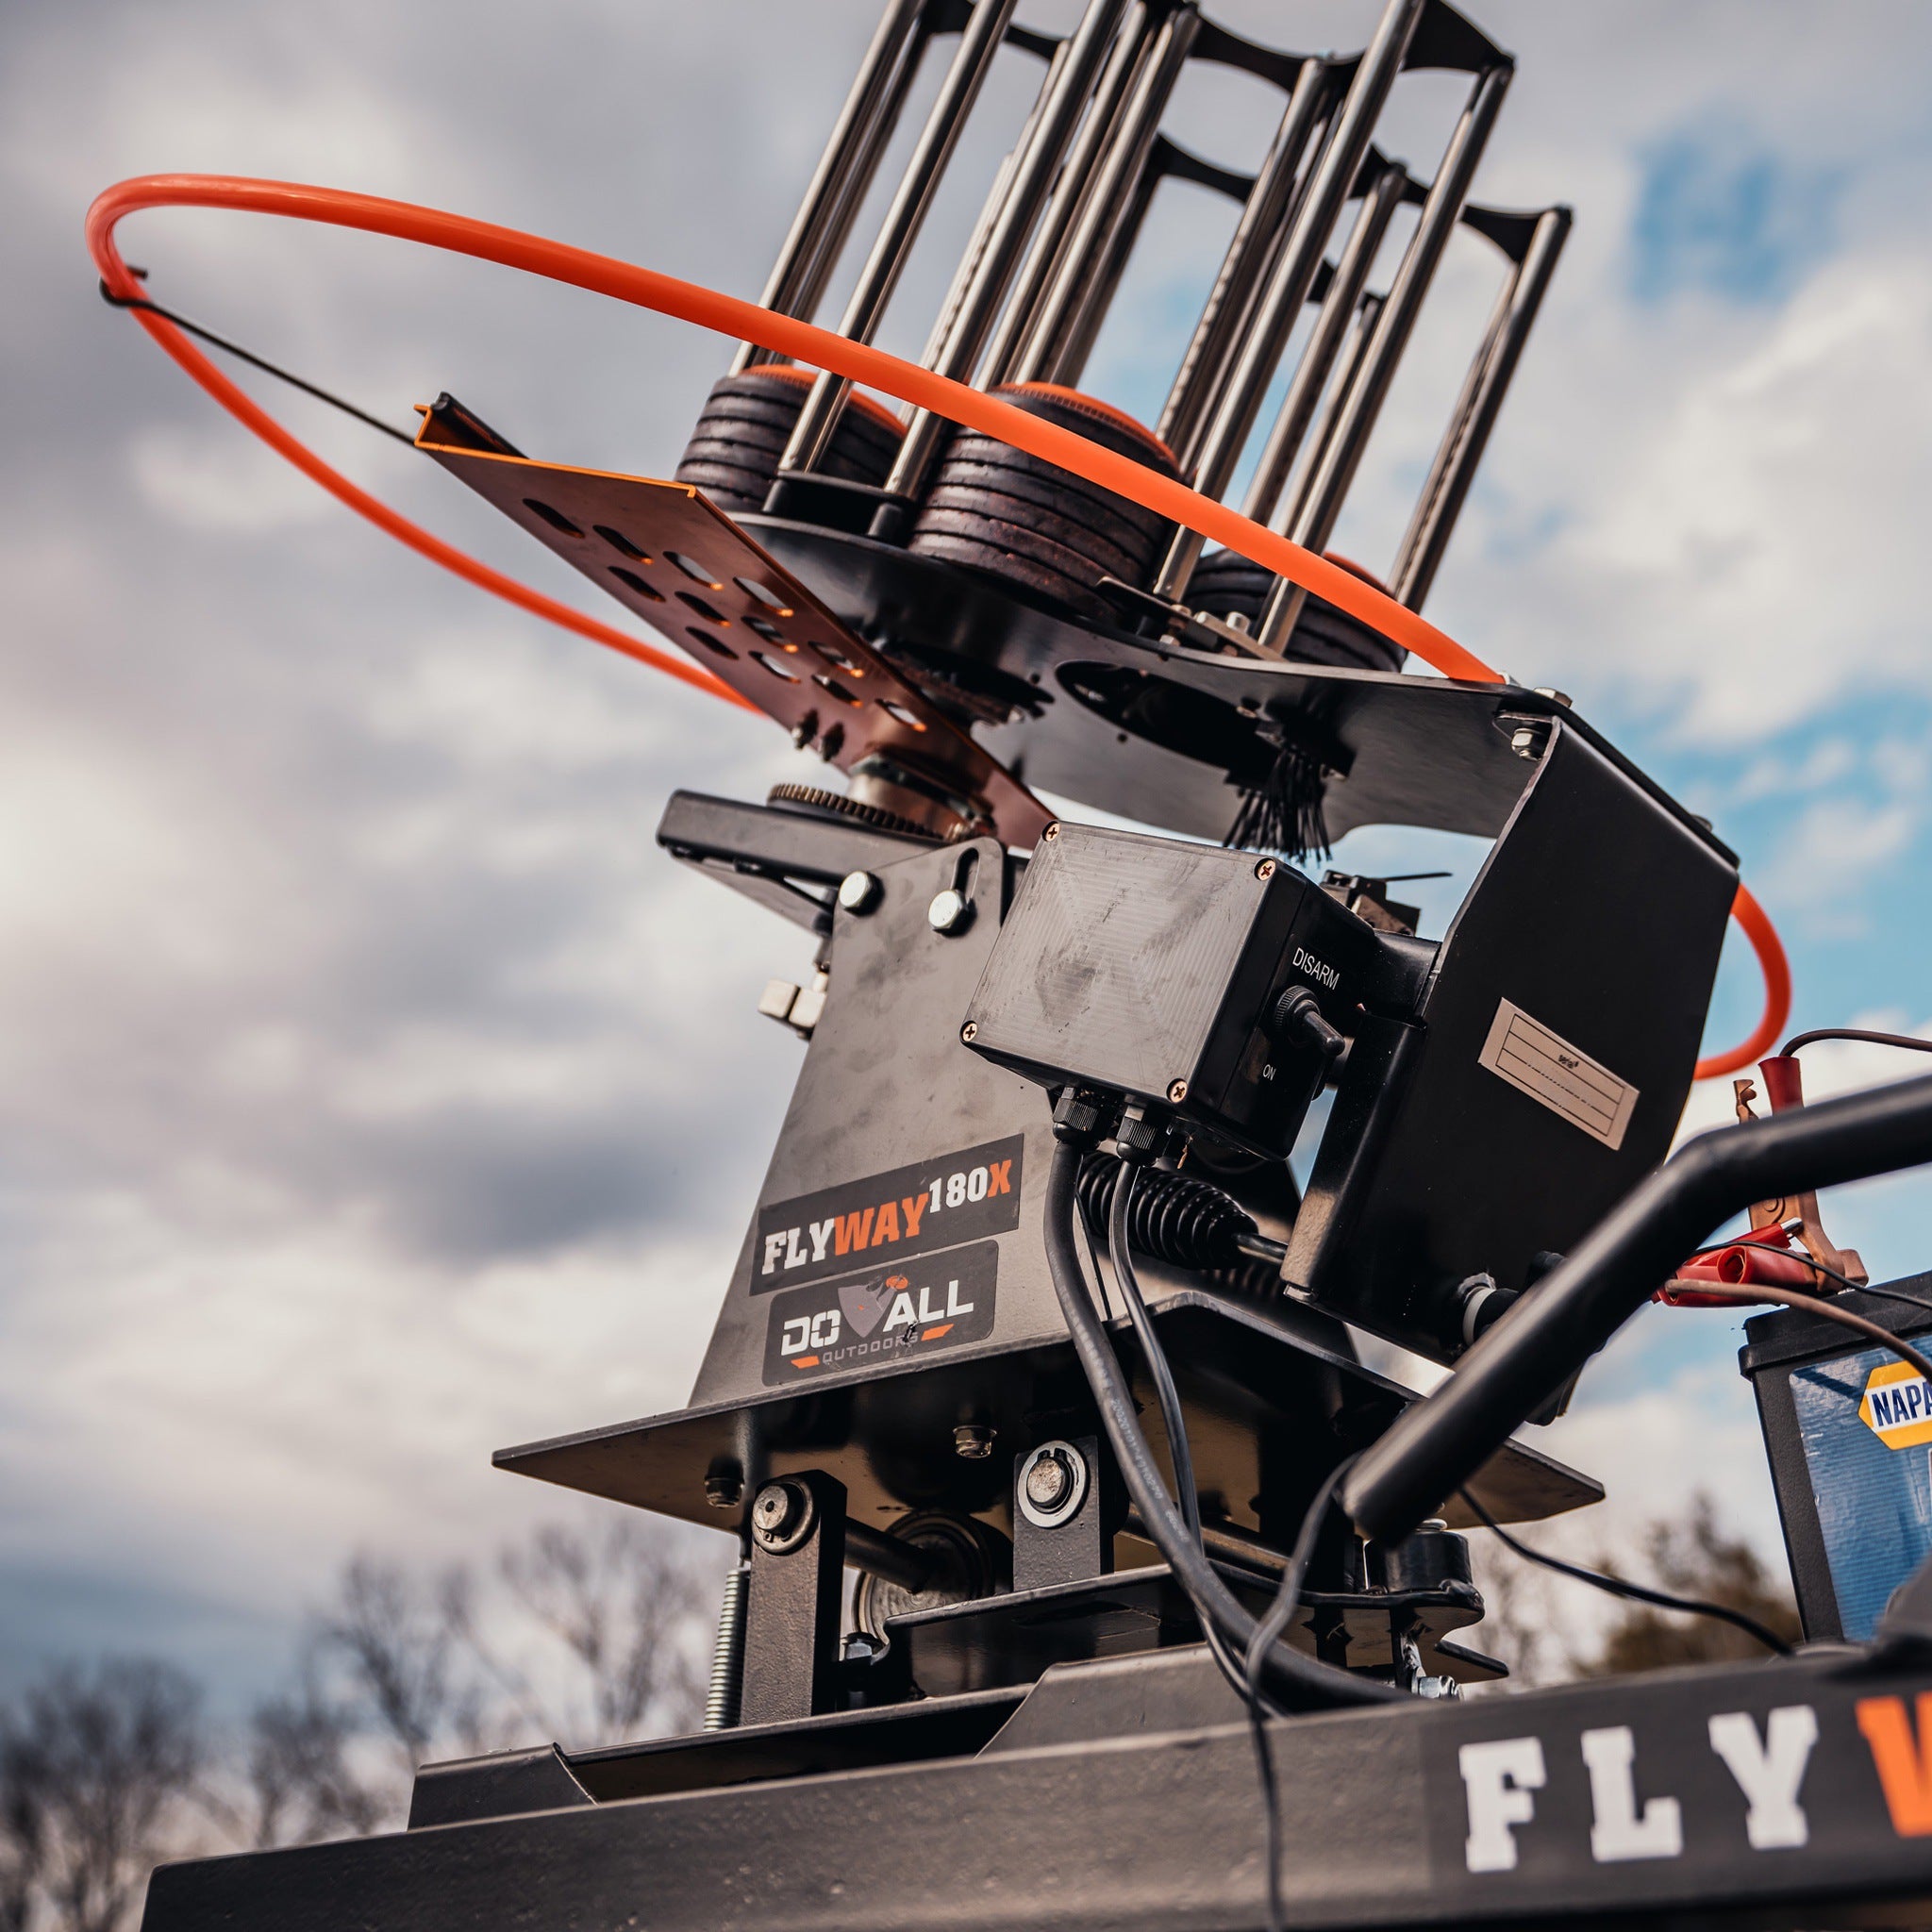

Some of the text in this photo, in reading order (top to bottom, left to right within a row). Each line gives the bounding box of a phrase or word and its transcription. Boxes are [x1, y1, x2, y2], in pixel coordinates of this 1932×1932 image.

[1292, 947, 1341, 991] DISARM
[1263, 1064, 1276, 1081] ON
[781, 1279, 974, 1356] DO ALL
